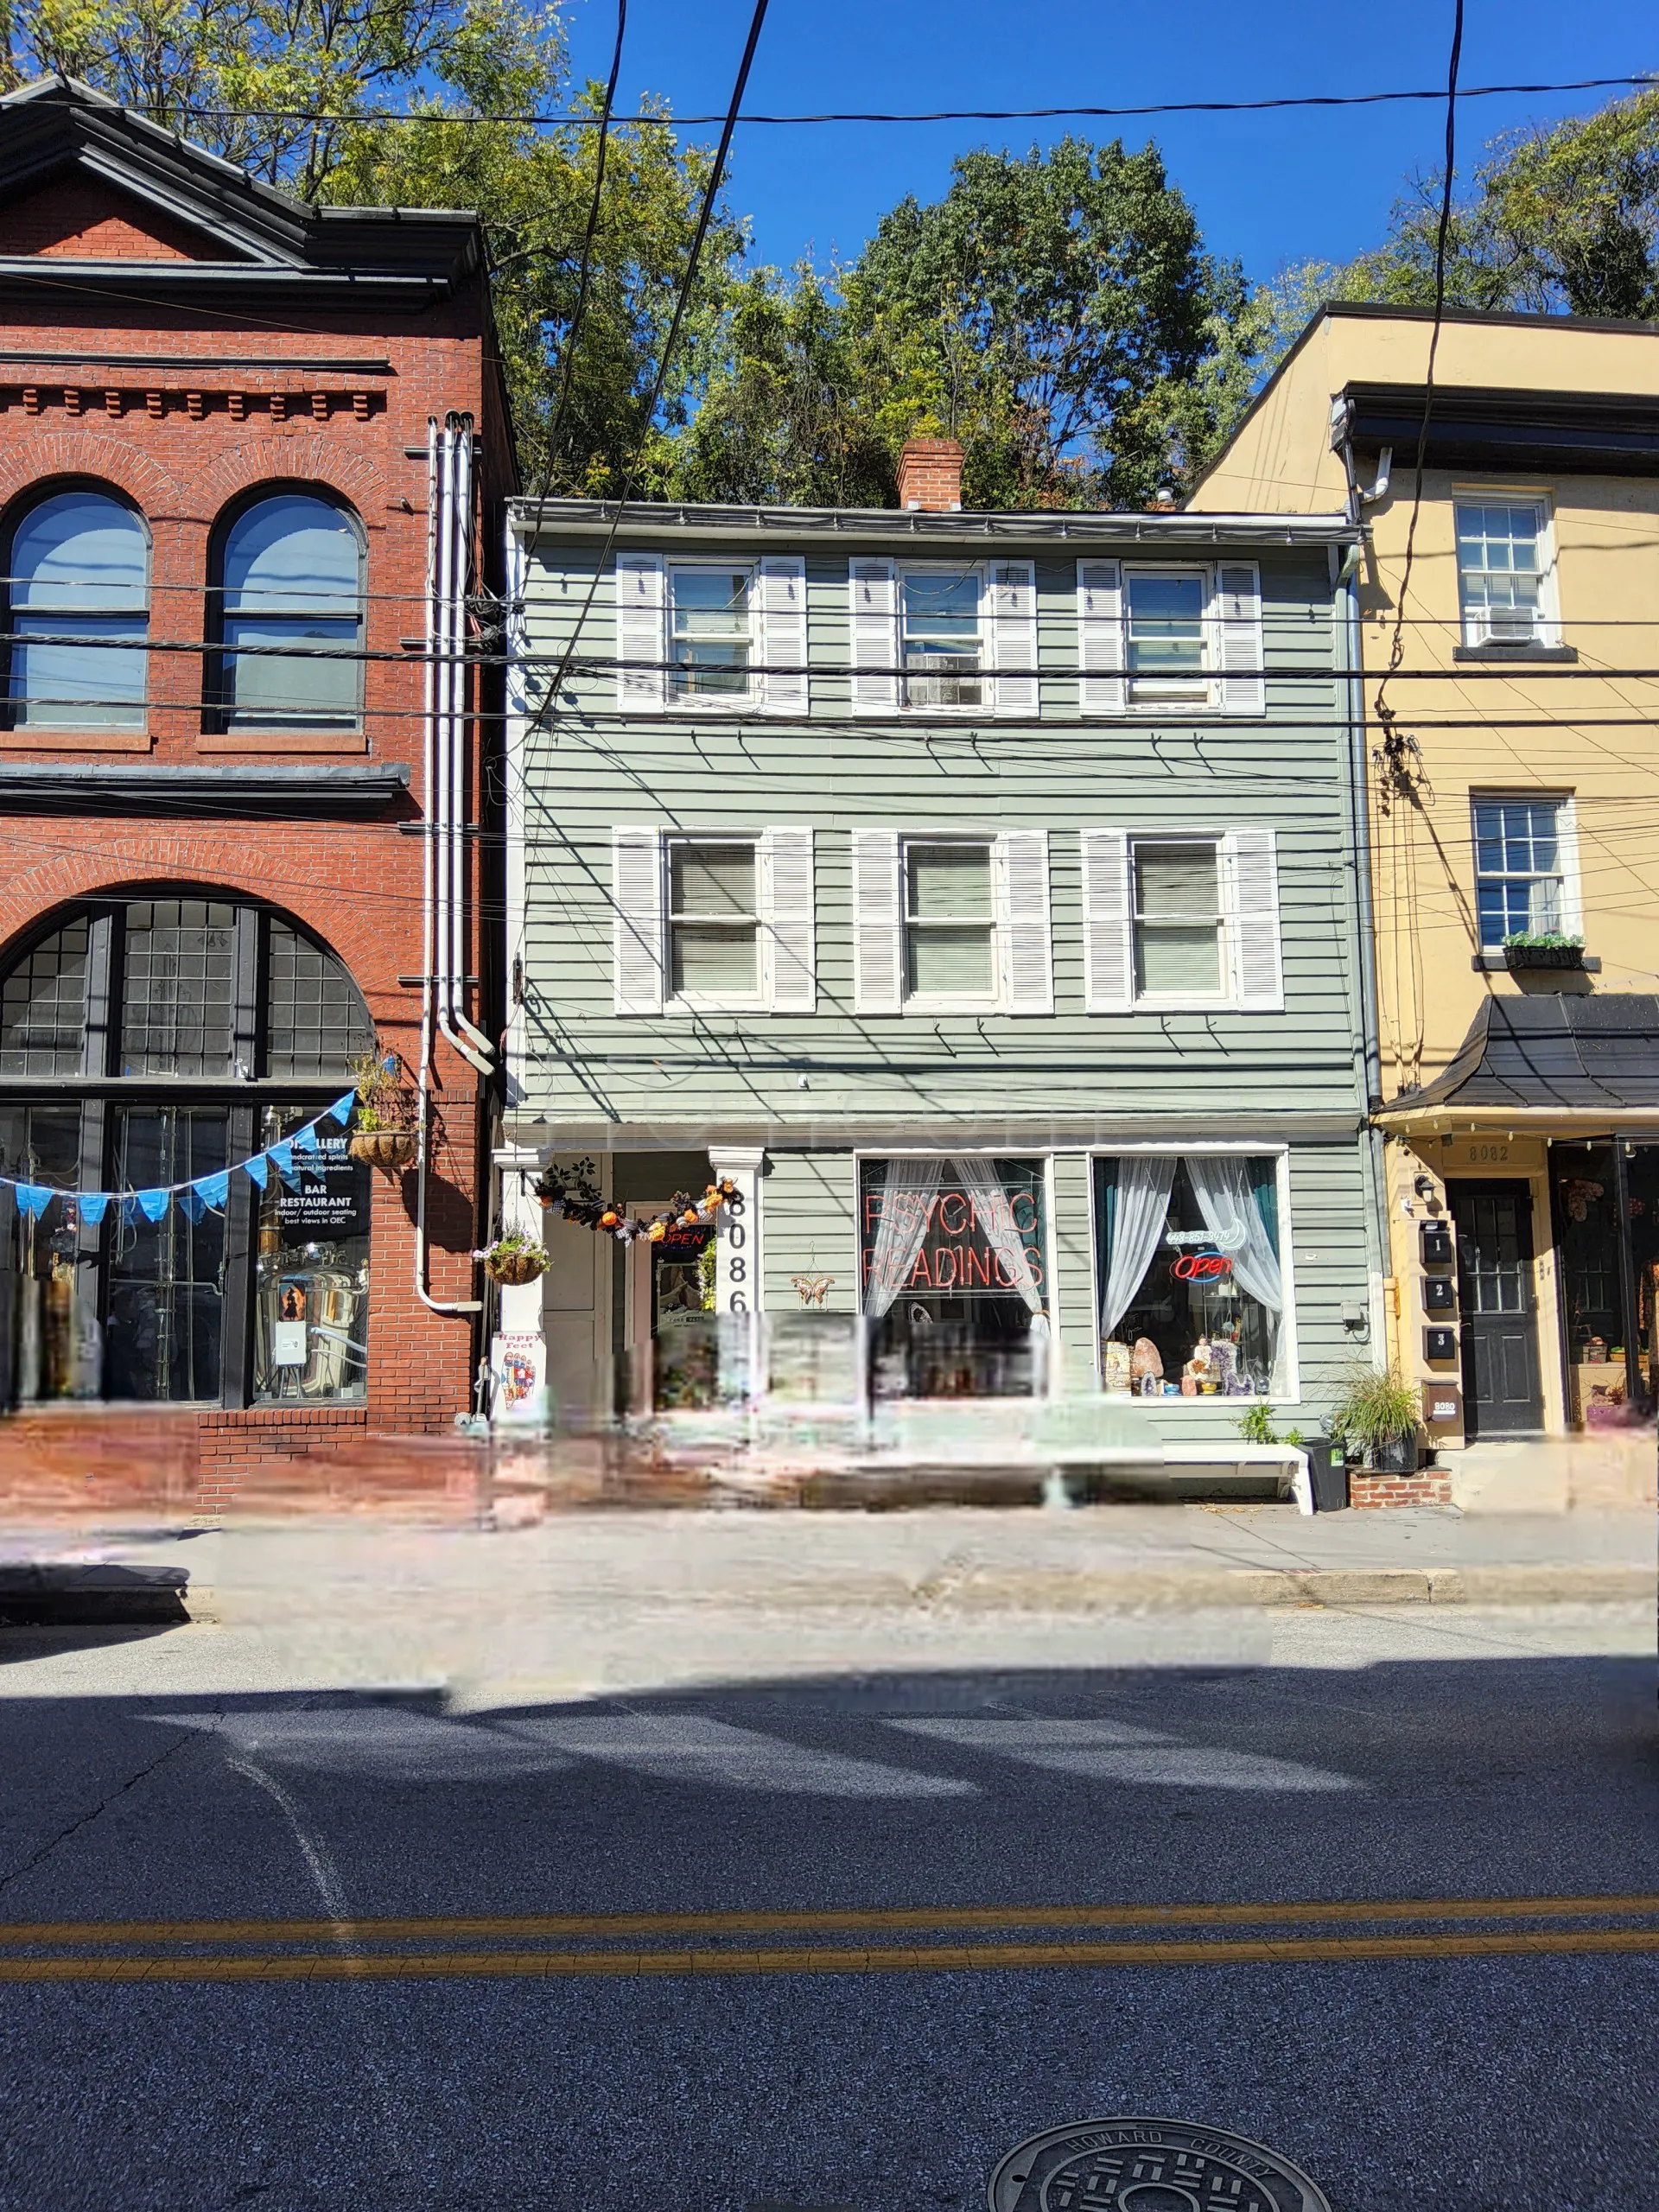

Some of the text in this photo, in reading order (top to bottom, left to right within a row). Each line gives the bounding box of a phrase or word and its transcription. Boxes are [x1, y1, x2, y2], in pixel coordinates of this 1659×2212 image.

[1470, 1145, 1508, 1160] 8082
[305, 1185, 327, 1194] BAR
[280, 1198, 352, 1207] RESTAURANT
[865, 1192, 1038, 1235] PSYCHIC
[661, 1233, 704, 1245] OPEN
[1435, 1239, 1441, 1251] 1
[729, 1186, 747, 1313] 8086
[862, 1245, 1043, 1287] READINGS
[1175, 1255, 1233, 1279] Open
[1436, 1284, 1444, 1296] 2
[499, 1333, 541, 1342] Happy
[1438, 1333, 1445, 1345] 3
[1434, 1402, 1456, 1410] 8080
[1066, 2130, 1277, 2178] HOWARD COUNTY
